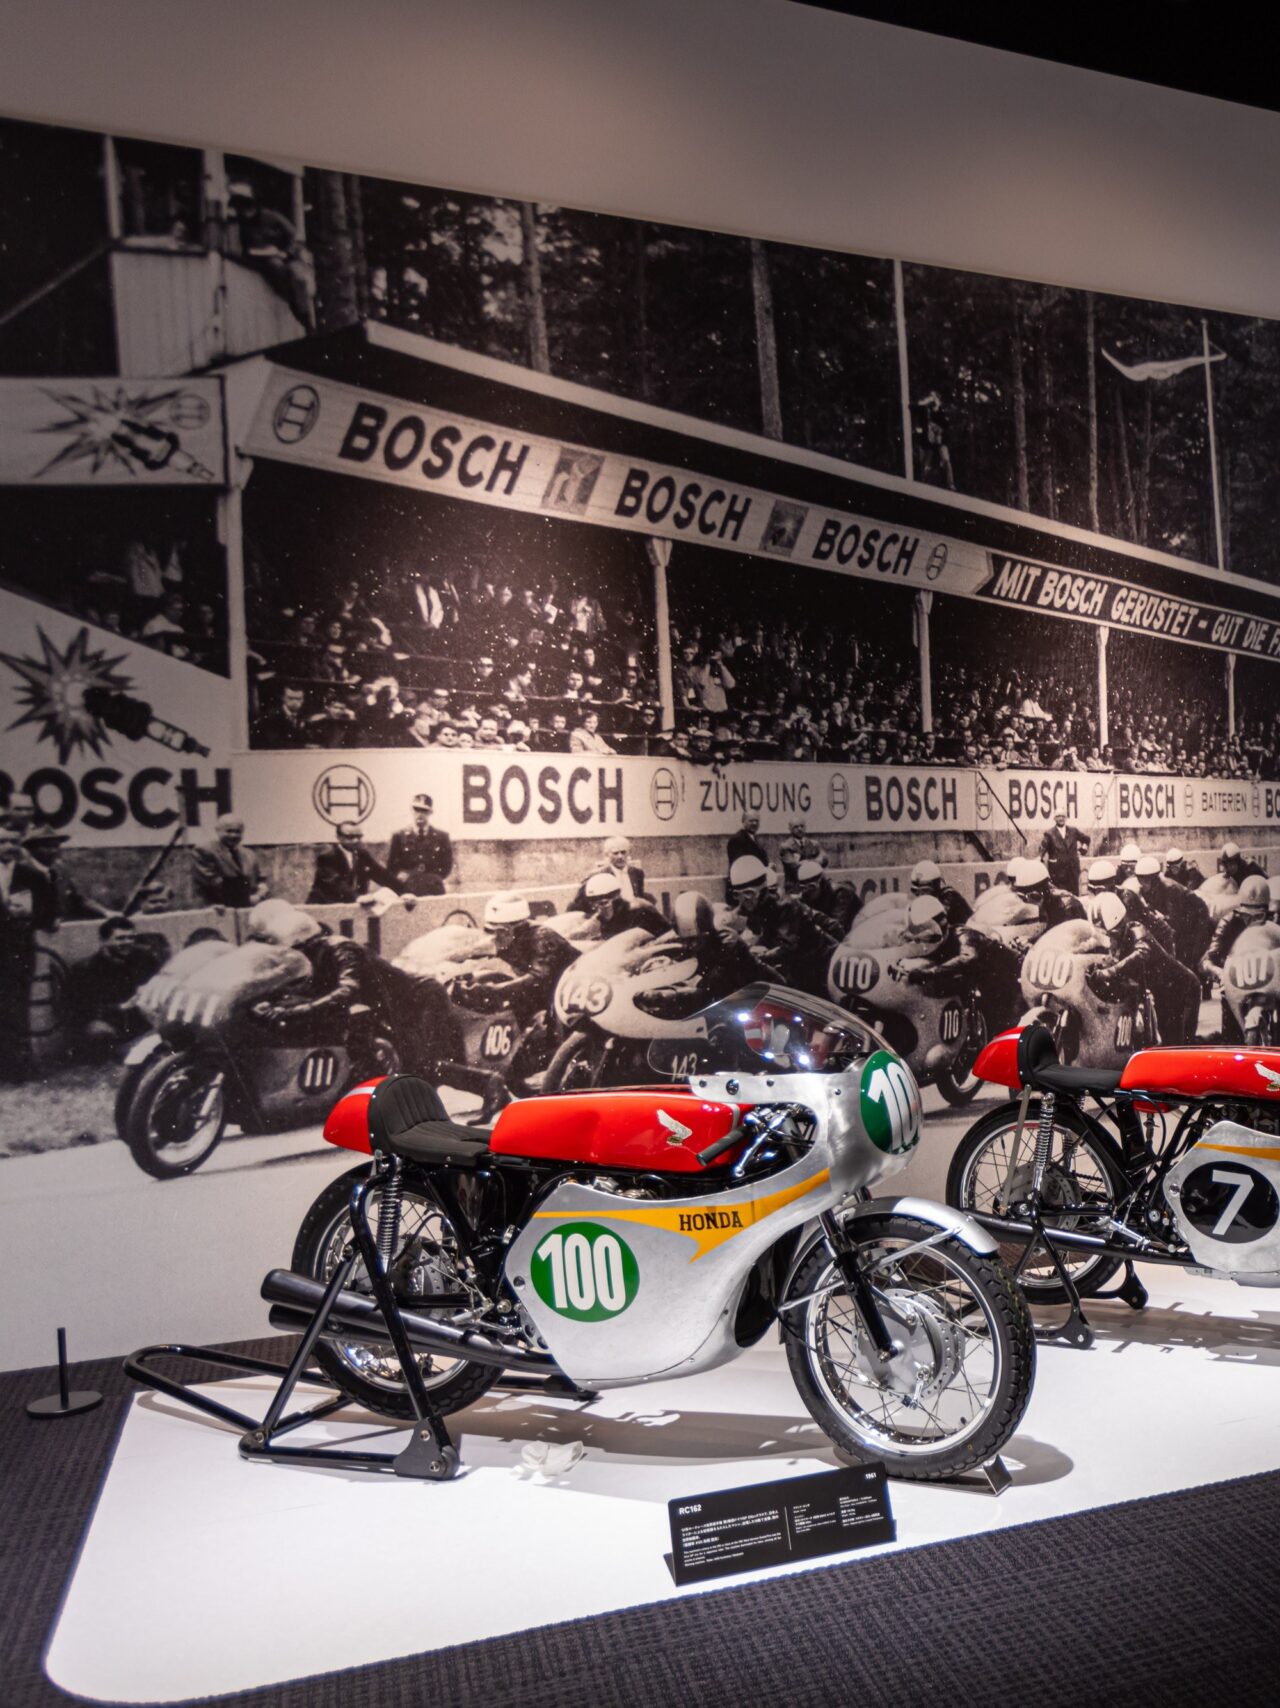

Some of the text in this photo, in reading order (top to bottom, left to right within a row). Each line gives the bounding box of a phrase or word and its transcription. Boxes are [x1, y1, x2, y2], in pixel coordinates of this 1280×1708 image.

[338, 401, 530, 495] BOSCH
[614, 467, 752, 542] BOSCH
[812, 518, 919, 577] BOSCH
[992, 561, 1041, 602] MIT
[1037, 569, 1111, 617] BOSCH
[1211, 614, 1246, 646] GUT
[1241, 619, 1269, 652] DIE
[0, 767, 233, 830] OSCH
[462, 764, 624, 825] BOSCH
[700, 774, 812, 814] ZÜNDUNG
[865, 775, 958, 822] BOSCH
[1009, 780, 1078, 821] BOSCH
[1119, 782, 1176, 819] BOSCH
[1201, 791, 1247, 812] BATTERIEN
[1029, 950, 1073, 988] 100
[560, 981, 610, 1014] 143
[485, 1024, 512, 1056] 106
[943, 1009, 960, 1041] 110
[1116, 1015, 1132, 1047] 100
[305, 1057, 334, 1088] 111
[671, 1052, 698, 1082] 143
[679, 1210, 744, 1232] HONDA
[1210, 1169, 1254, 1236] 7
[537, 1232, 627, 1311] 100
[865, 1472, 877, 1480] 1961
[679, 1504, 702, 1515] RC162
